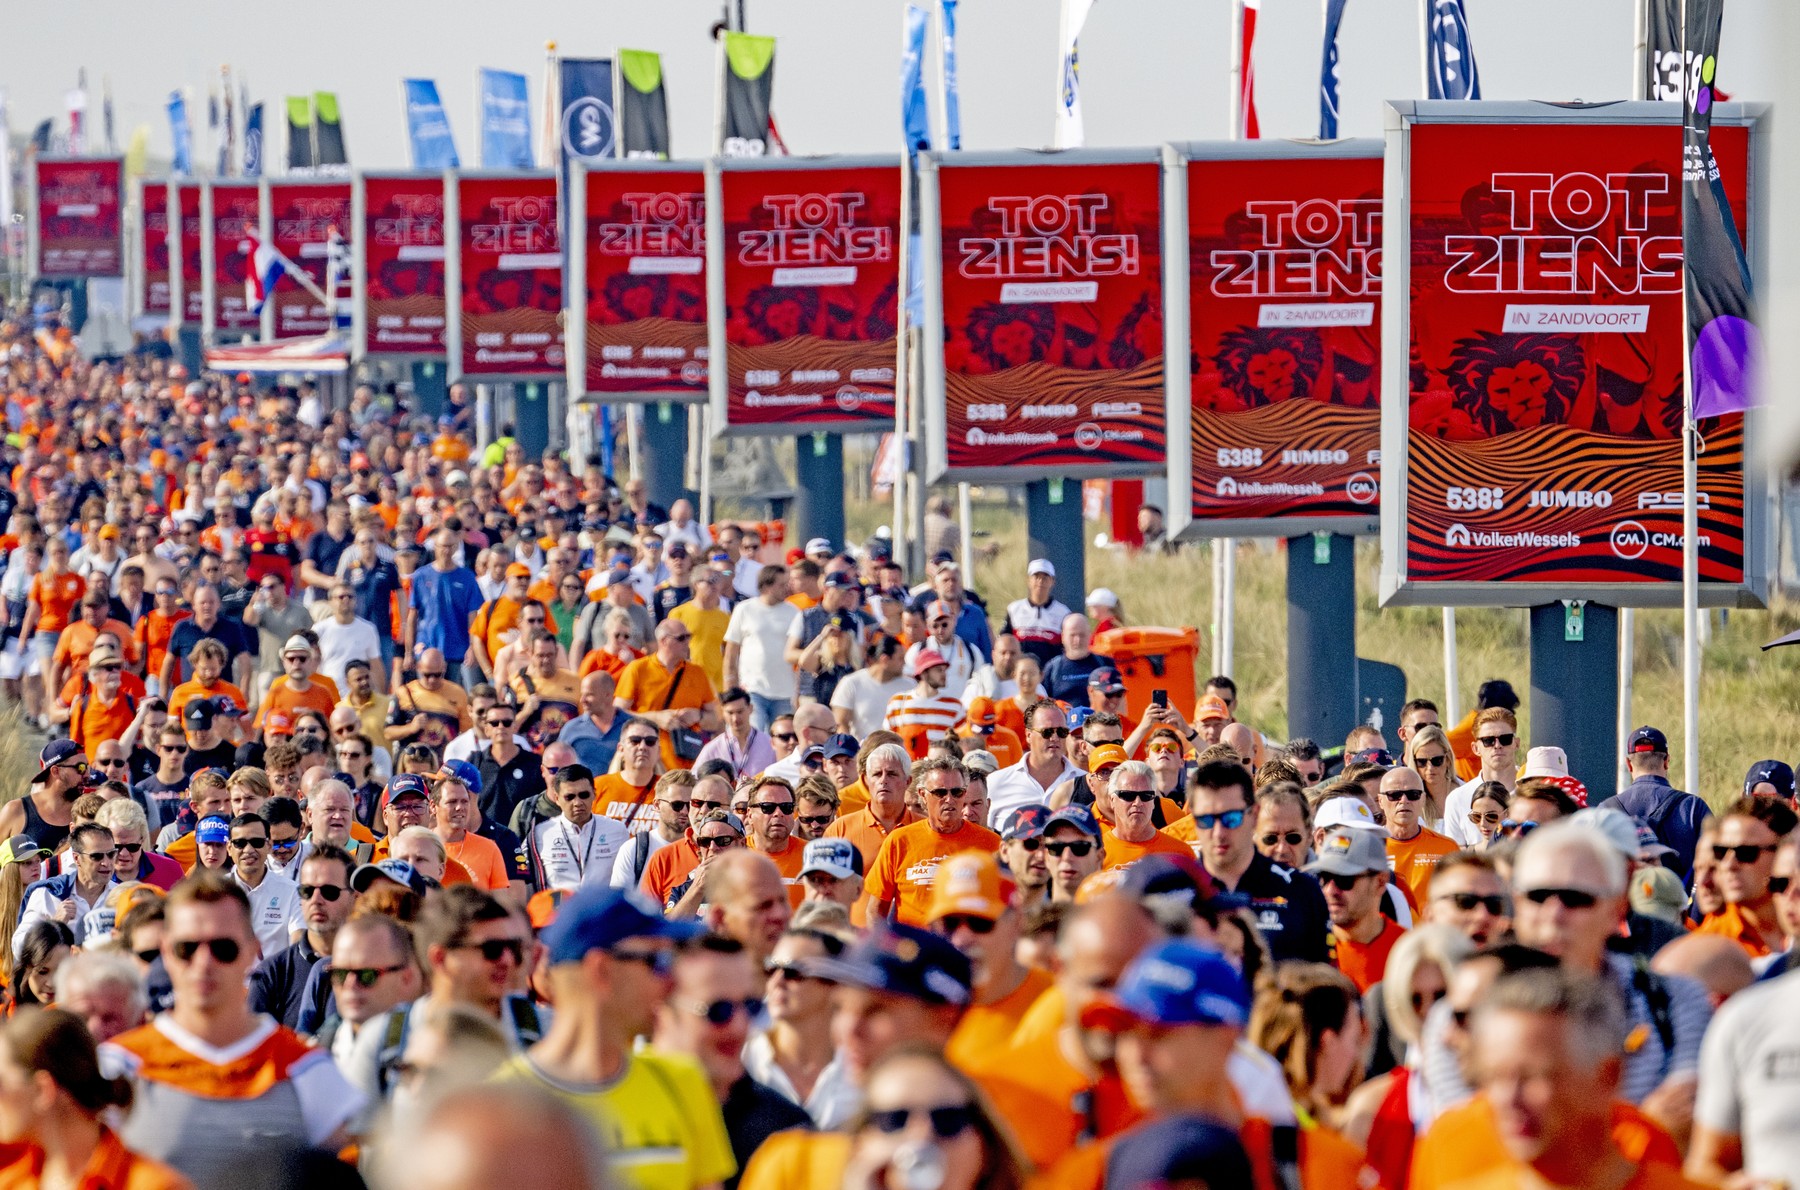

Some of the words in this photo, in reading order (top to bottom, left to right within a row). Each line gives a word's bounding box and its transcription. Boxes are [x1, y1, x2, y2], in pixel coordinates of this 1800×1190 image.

[763, 192, 865, 230] TOT
[988, 193, 1107, 237] TOT
[1492, 172, 1669, 232] TOT
[471, 223, 561, 252] ZIEN
[599, 223, 705, 256] ZIEN
[1246, 198, 1383, 247] TOT
[738, 226, 892, 266] ZIENS!
[958, 234, 1139, 279] ZIENS!
[1210, 248, 1383, 298] ZIEN
[1444, 235, 1683, 294] ZIENS
[1265, 310, 1280, 320] IN
[1284, 309, 1367, 320] ZANDVOORT
[1512, 312, 1530, 325] IN
[1537, 312, 1642, 325] ZANDVOORT
[1281, 449, 1349, 465] JUMBO
[1237, 482, 1325, 496] VolkerWessels
[1527, 490, 1613, 509] JUMBO
[1472, 531, 1581, 548] VolkerWessels
[1652, 533, 1711, 547] CM.cm
